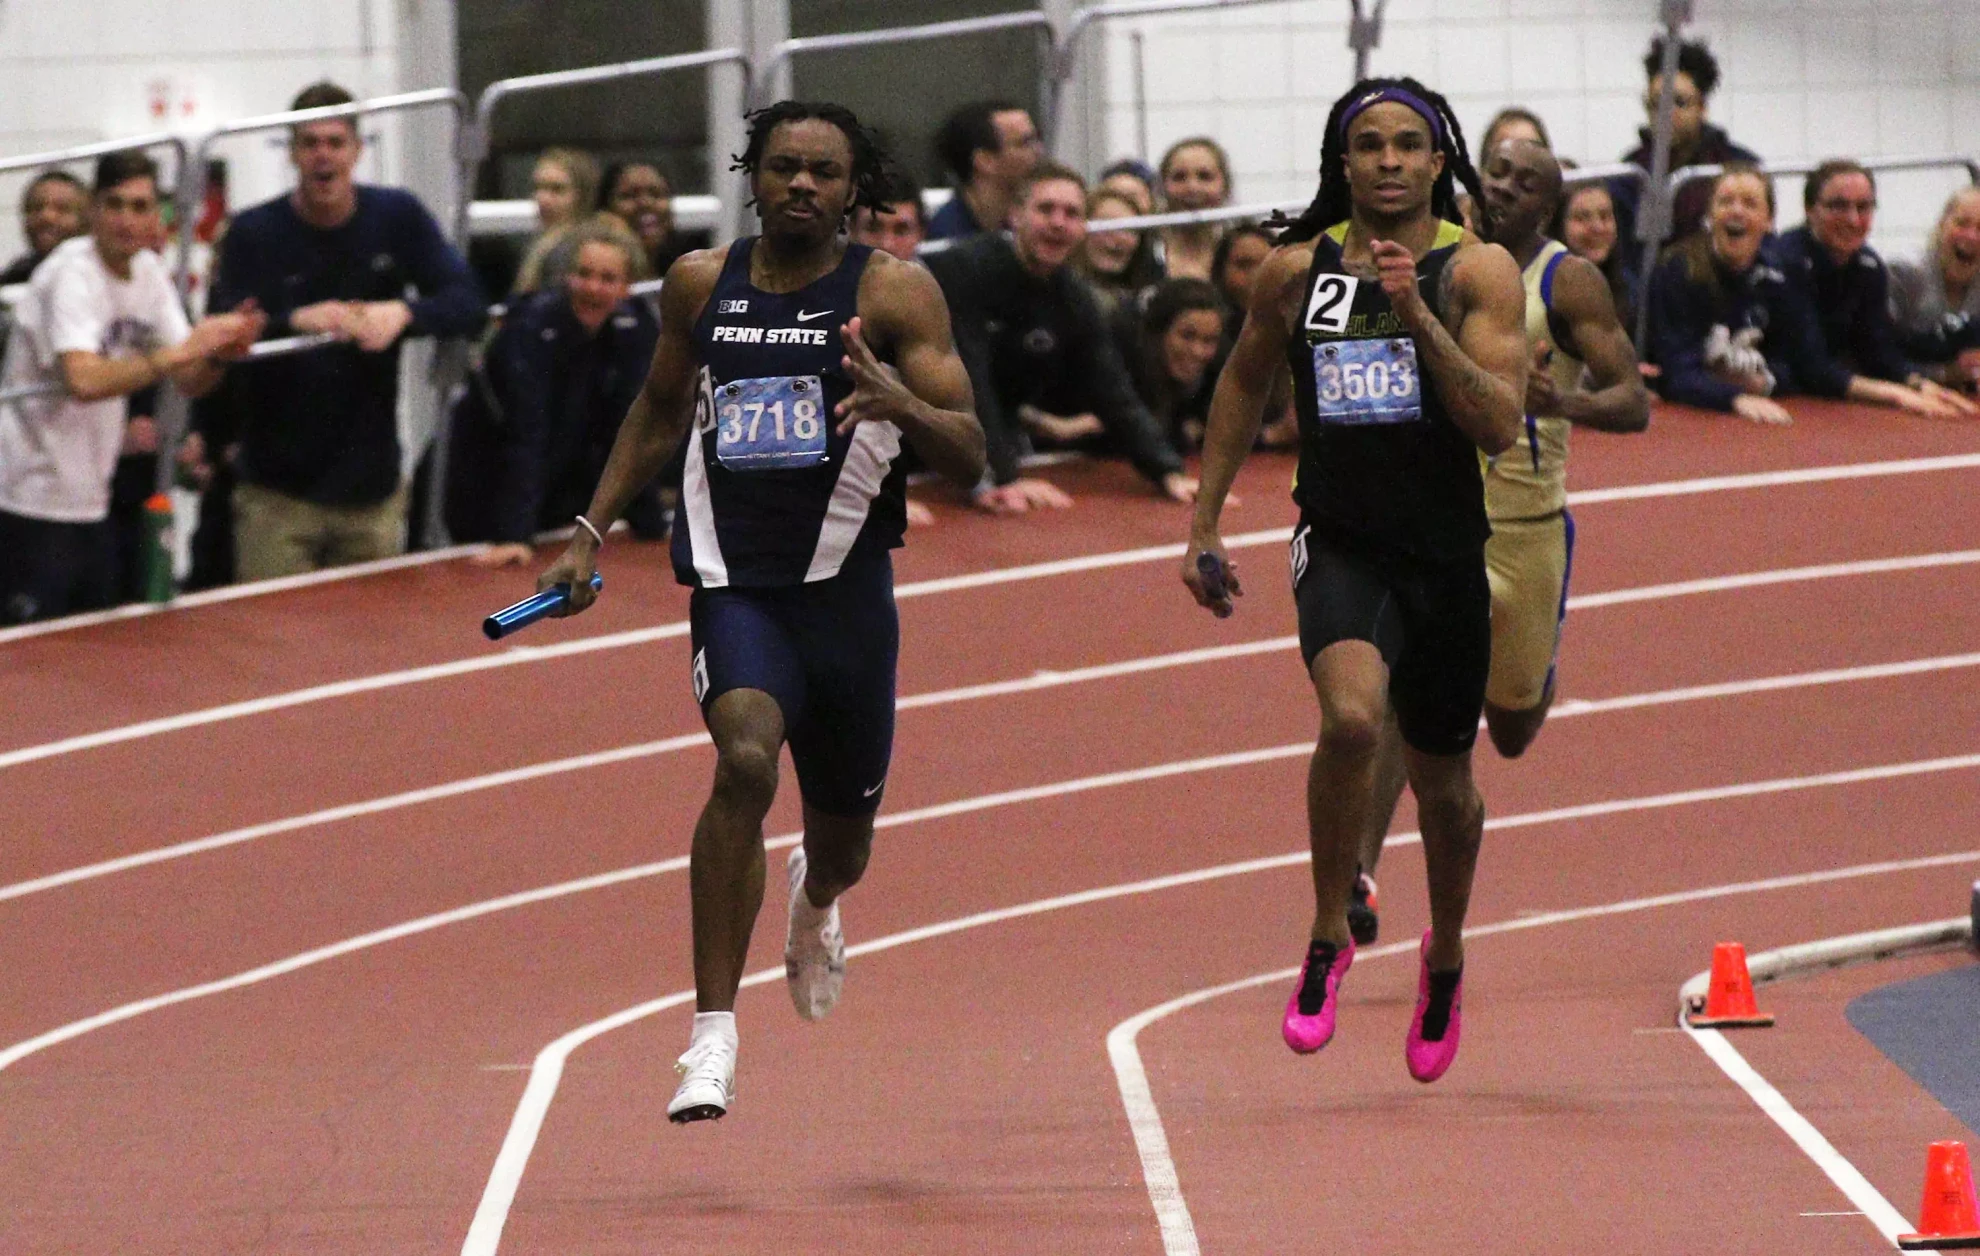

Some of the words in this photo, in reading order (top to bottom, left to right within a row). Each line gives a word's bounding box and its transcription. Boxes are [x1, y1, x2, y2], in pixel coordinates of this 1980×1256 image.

[1310, 278, 1347, 327] 2
[712, 326, 764, 344] PENN
[766, 328, 828, 345] STATE
[1321, 361, 1413, 402] 3503
[722, 399, 818, 444] 3718
